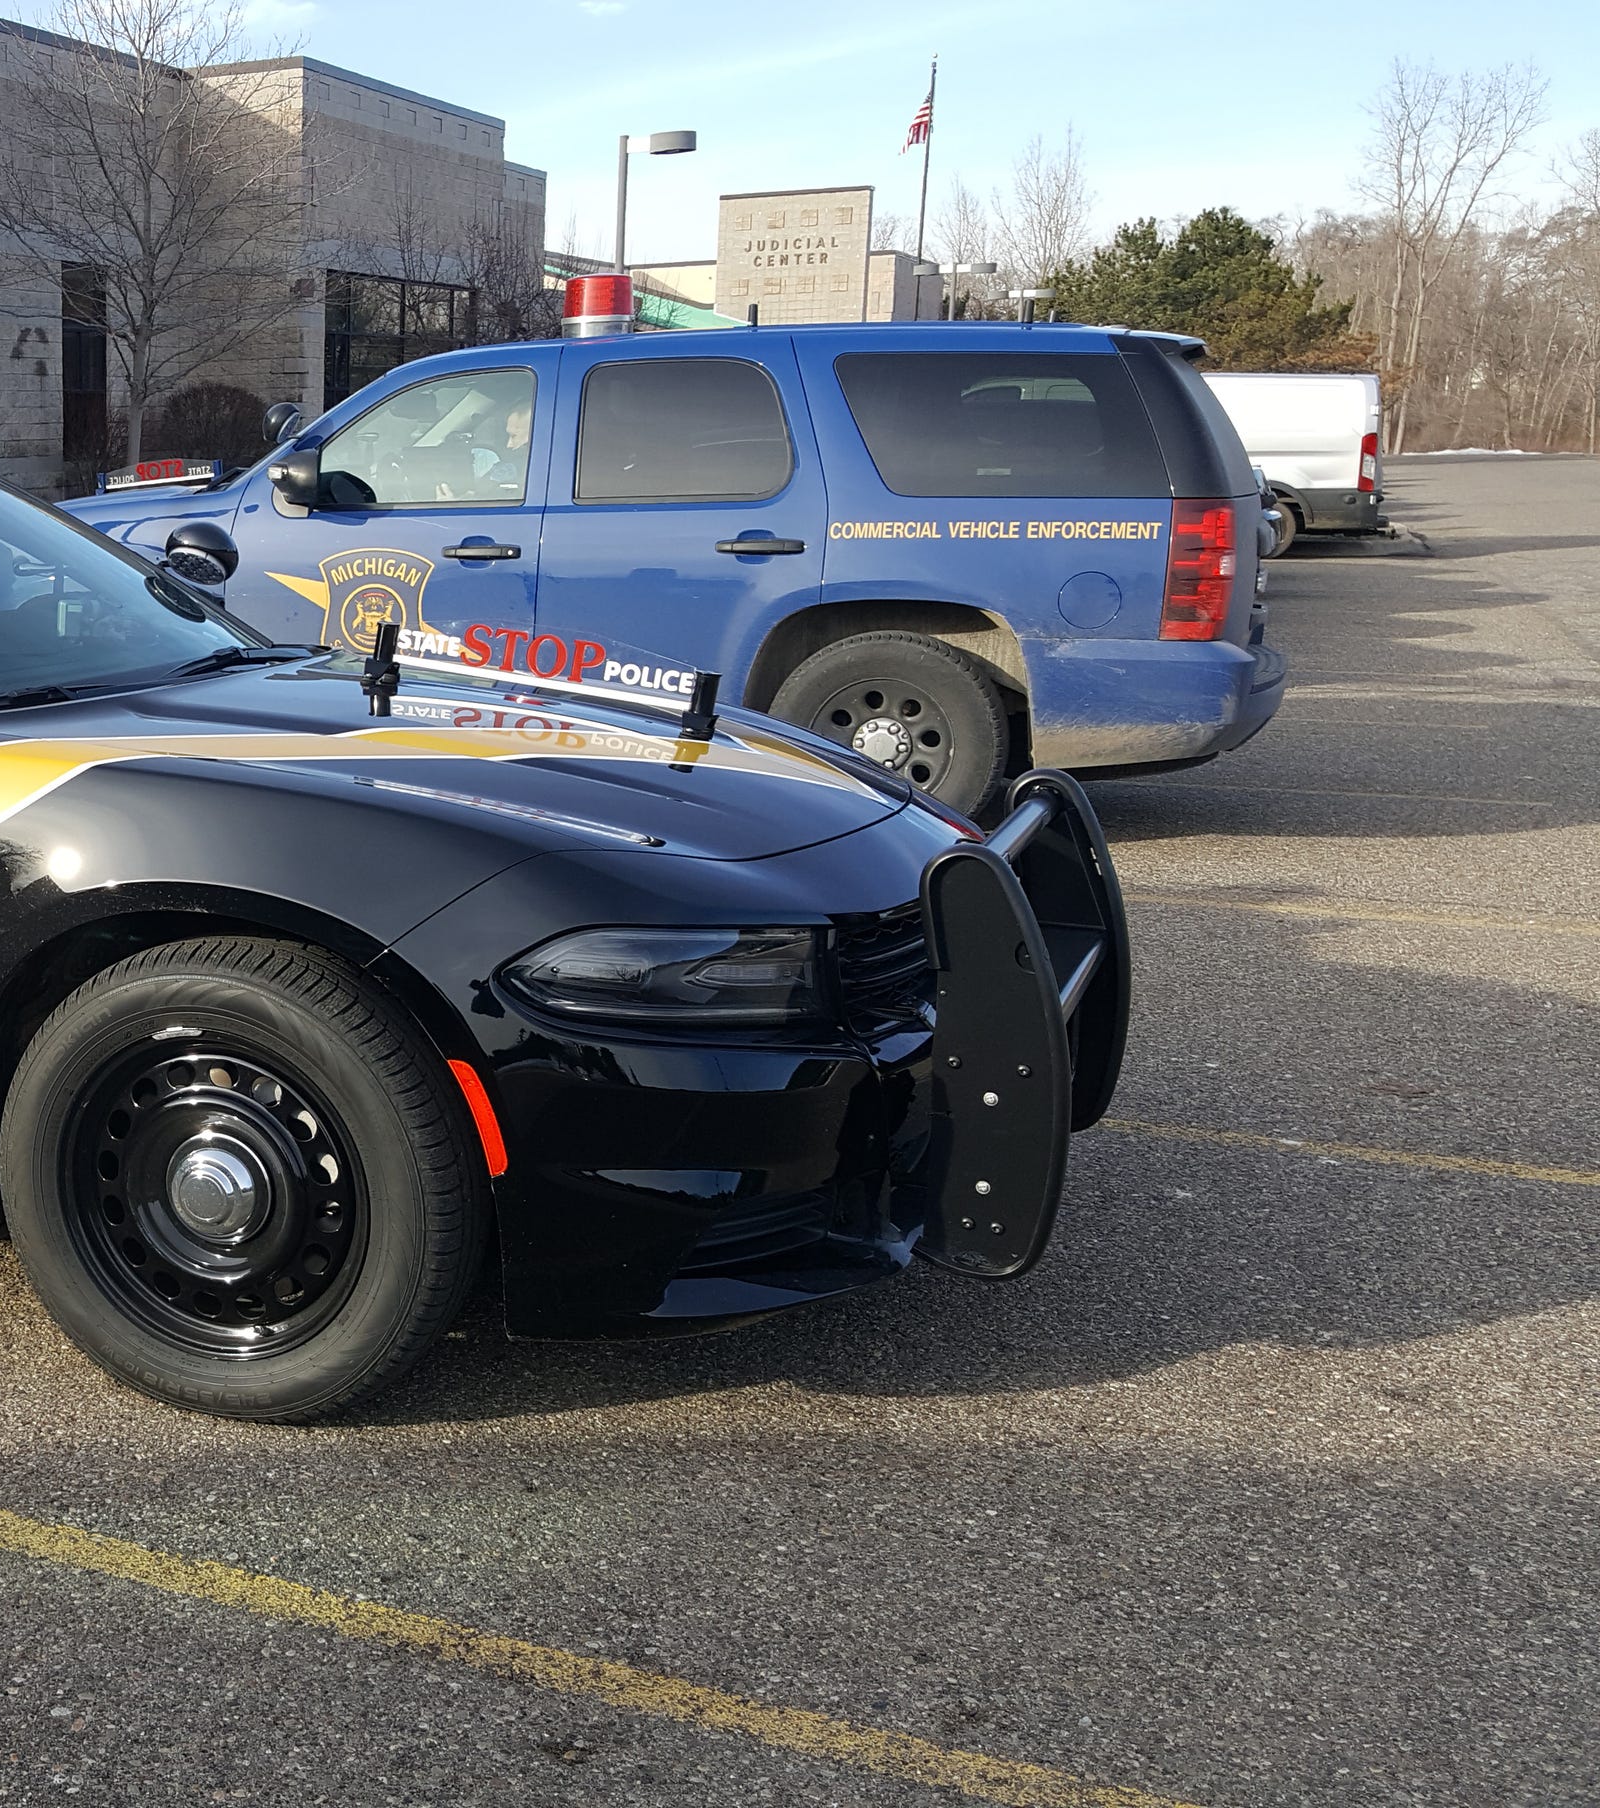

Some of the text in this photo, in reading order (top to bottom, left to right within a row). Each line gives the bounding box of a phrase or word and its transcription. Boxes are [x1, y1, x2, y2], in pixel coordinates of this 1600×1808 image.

[744, 237, 838, 252] JUDICIAL
[754, 253, 828, 267] CENTER
[829, 521, 1163, 540] COMMERCIAL VEHICLE ENFORCEMENT
[329, 557, 423, 588] MICHIGAN
[398, 624, 695, 694] STATE STOP POLICE
